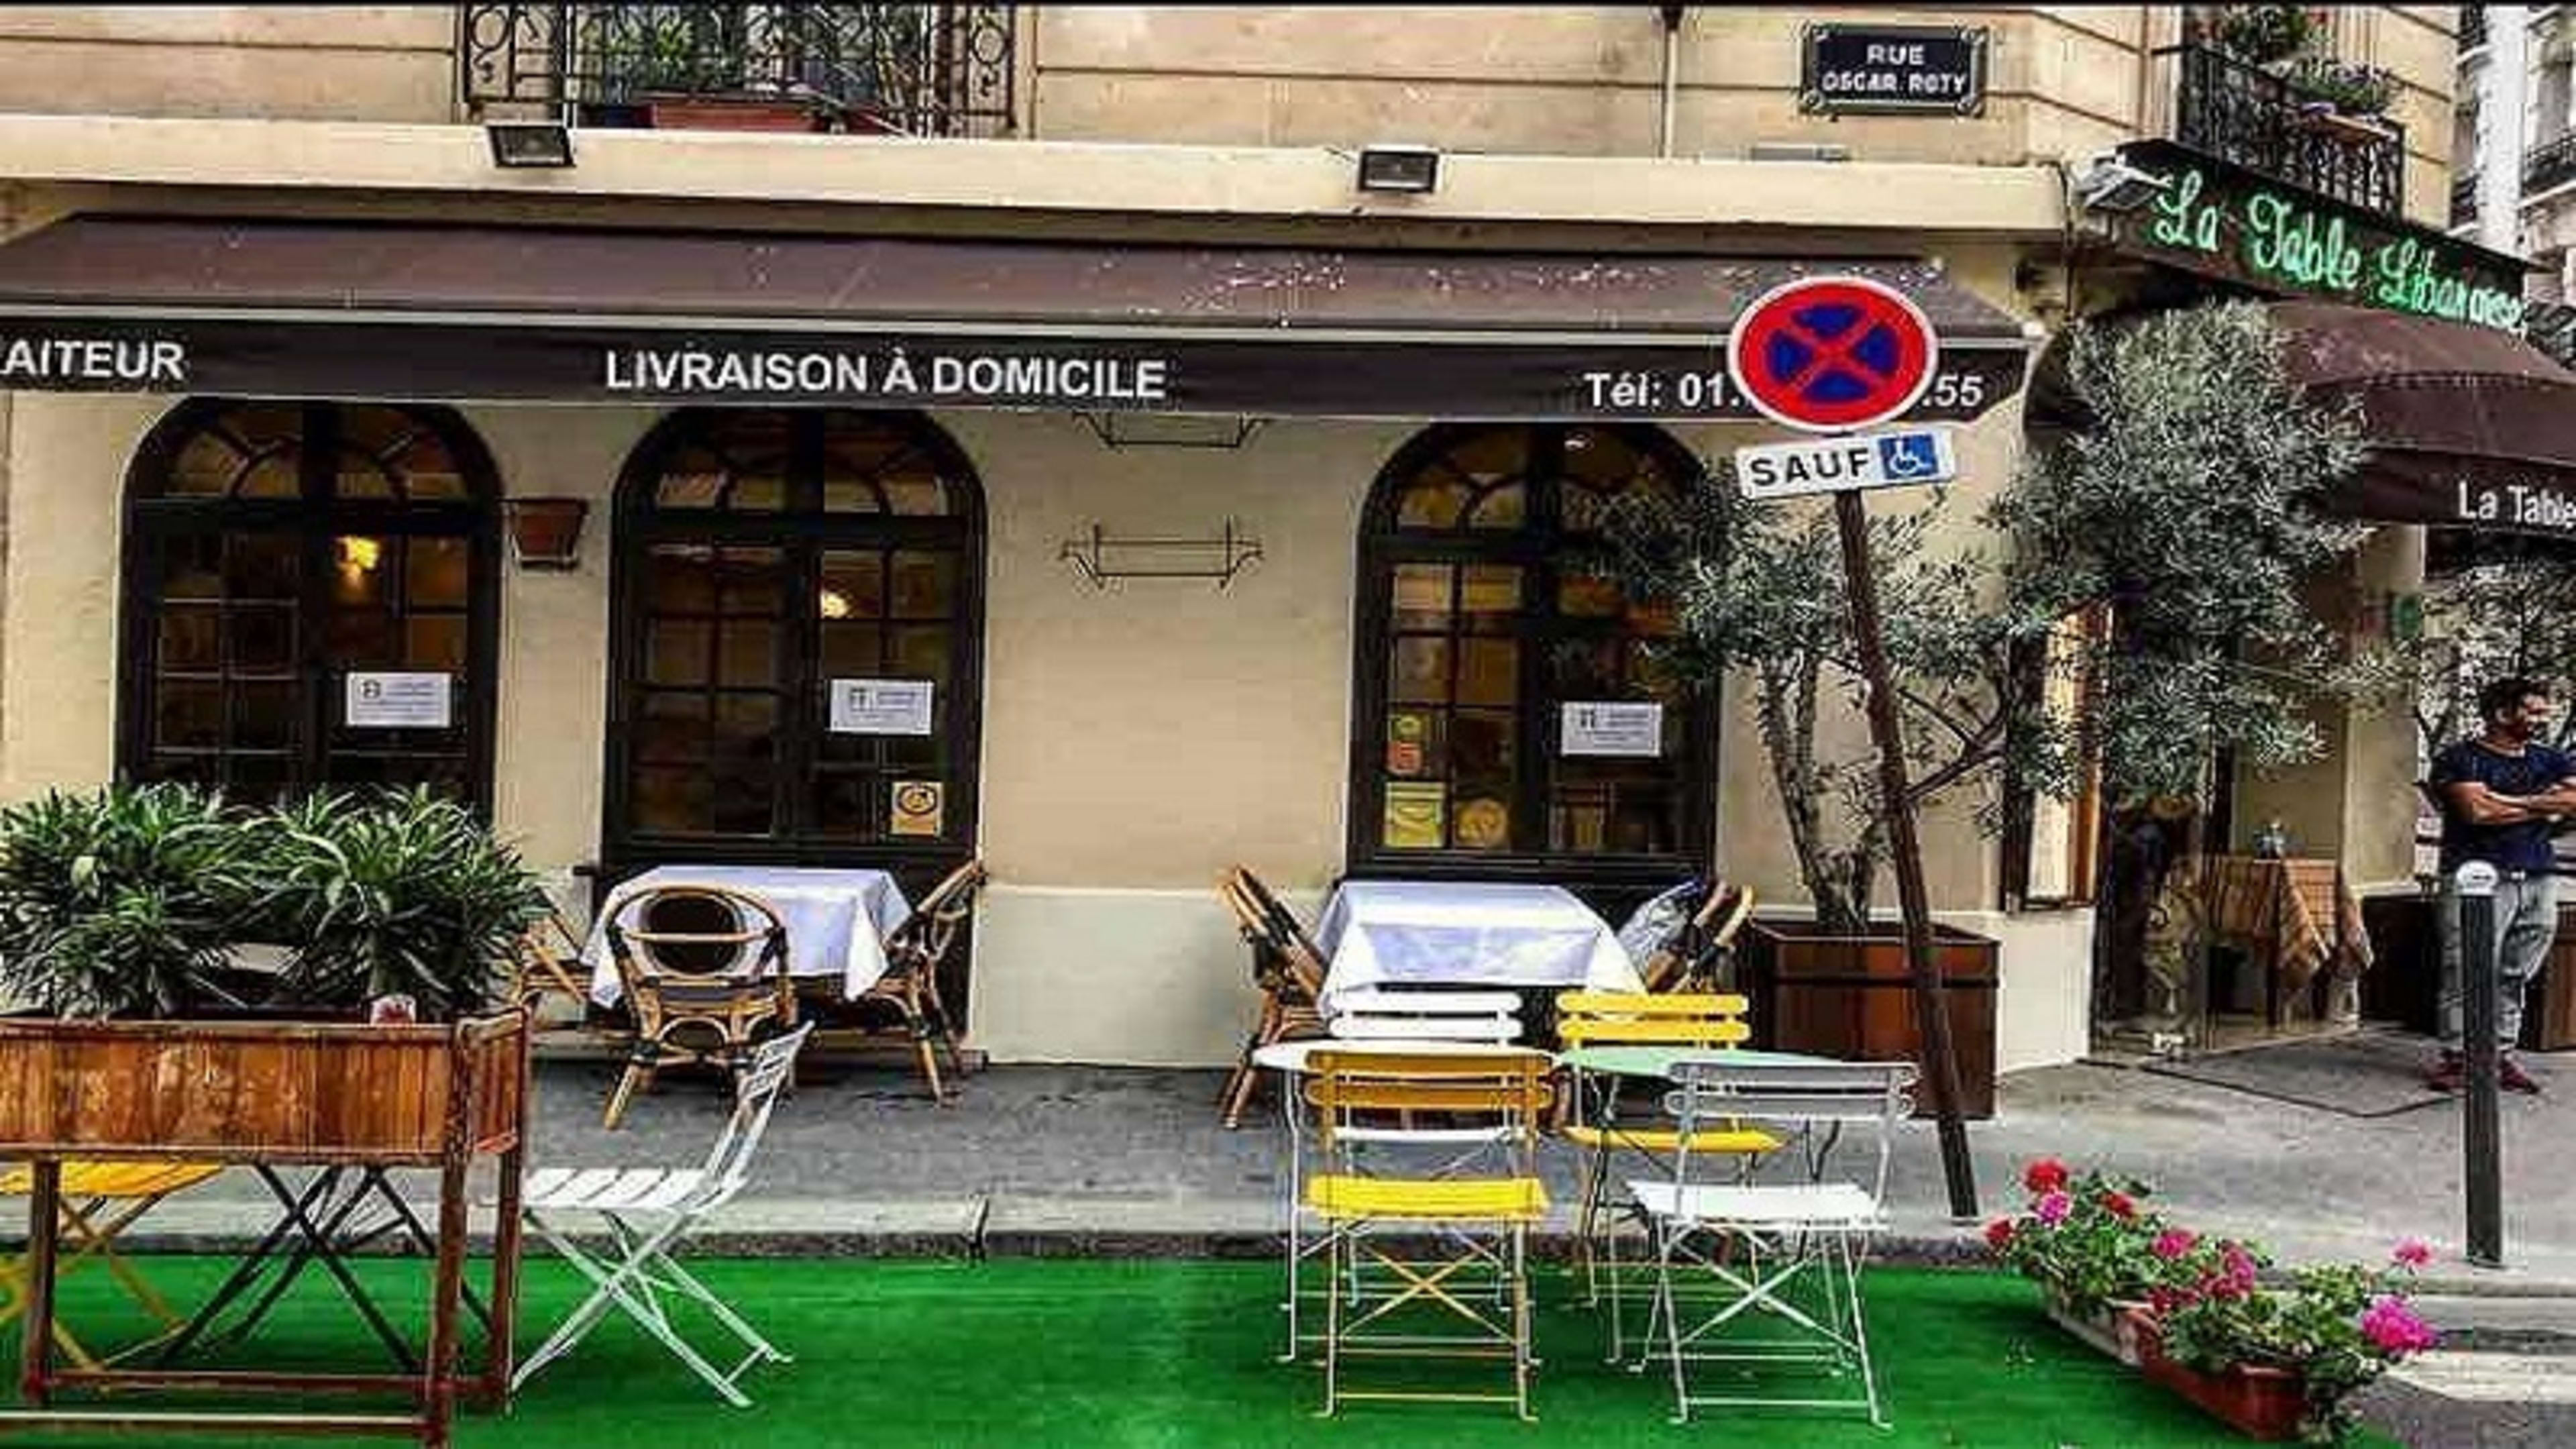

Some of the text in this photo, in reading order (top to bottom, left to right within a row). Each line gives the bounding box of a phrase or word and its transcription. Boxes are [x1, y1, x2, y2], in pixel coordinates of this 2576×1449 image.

[1866, 44, 1924, 65] RUE
[1821, 70, 1967, 93] OSCAR ROTY
[2154, 170, 2219, 251] La
[2248, 194, 2361, 288] Table
[0, 339, 184, 380] AITEUR
[607, 347, 1167, 398] LIVRAISON À DOMICILE
[1583, 372, 1661, 407] Tél:
[1750, 447, 1869, 486] SAUF
[2459, 480, 2498, 519] La
